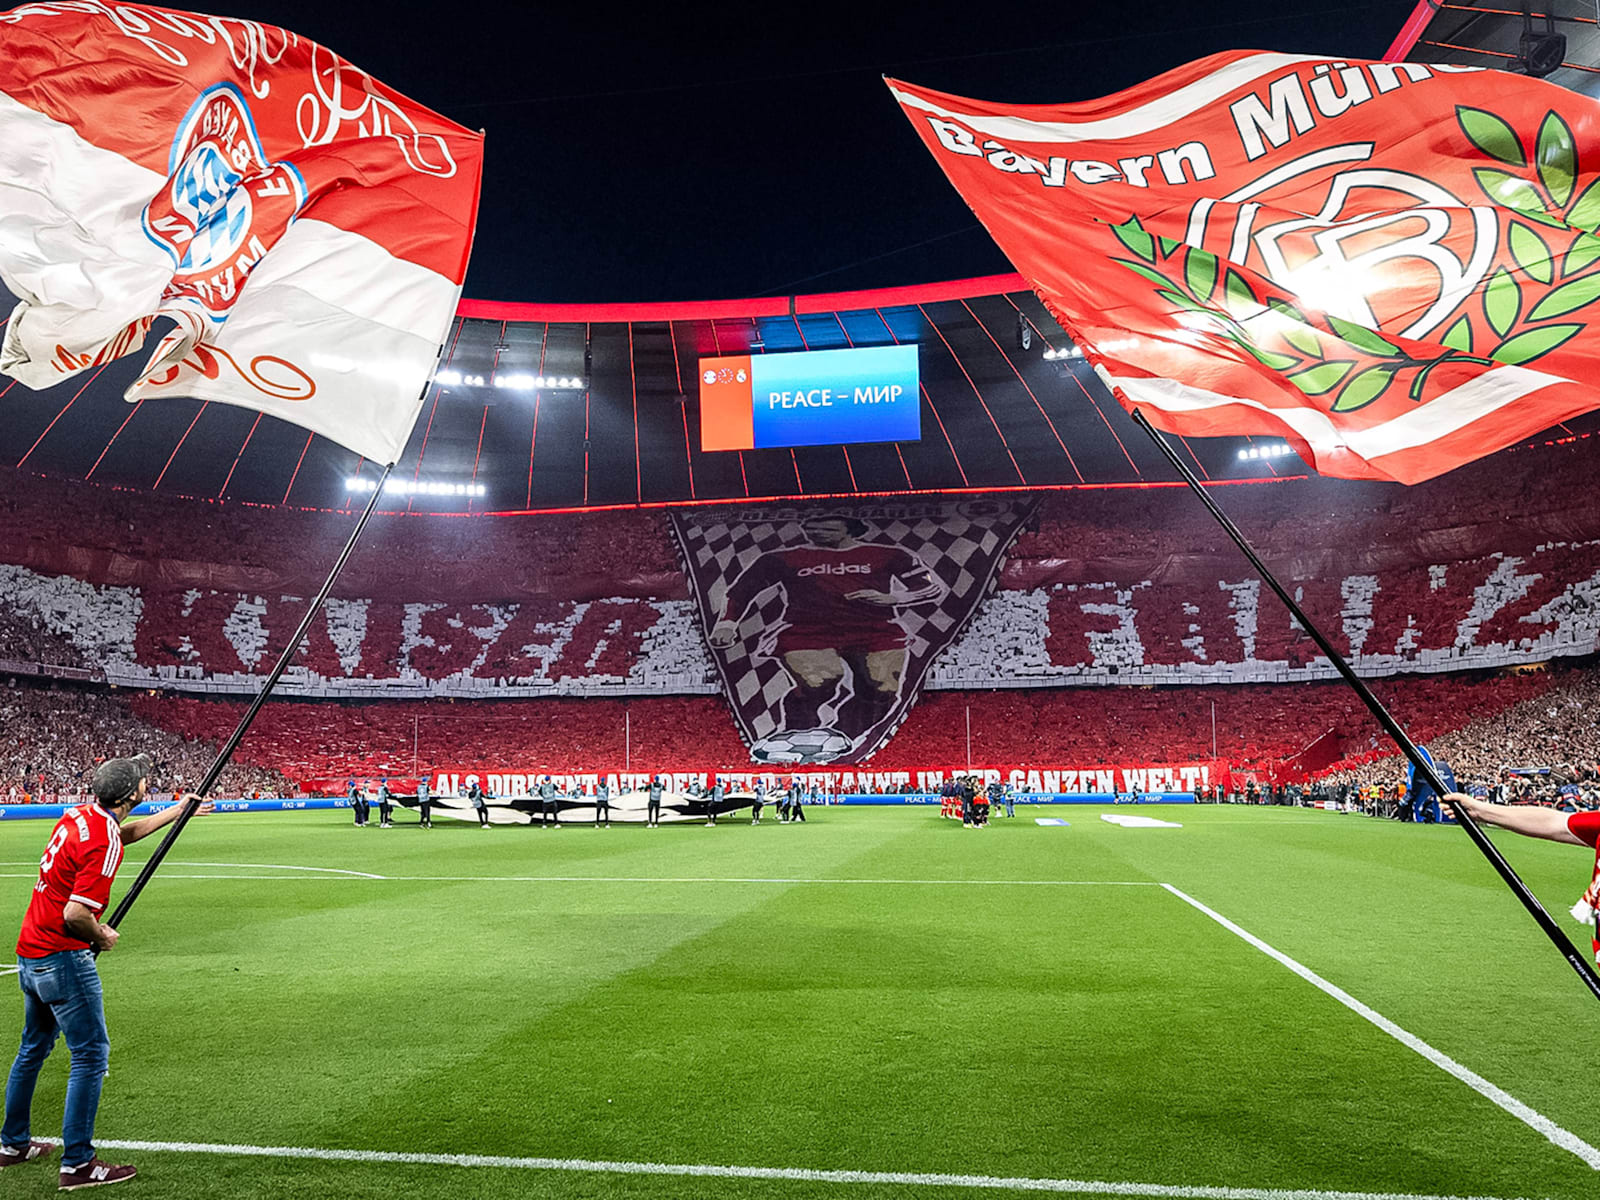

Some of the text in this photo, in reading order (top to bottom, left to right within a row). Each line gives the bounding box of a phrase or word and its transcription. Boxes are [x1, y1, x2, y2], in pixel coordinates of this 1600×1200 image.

[926, 60, 1488, 188] Bayern Mün
[769, 389, 832, 409] PEACE
[853, 385, 902, 404] МИР
[797, 562, 871, 576] adidas
[917, 770, 944, 794] IN
[1009, 769, 1114, 793] GANZEN
[1122, 766, 1209, 792] WELT!
[89, 1165, 110, 1180] N
